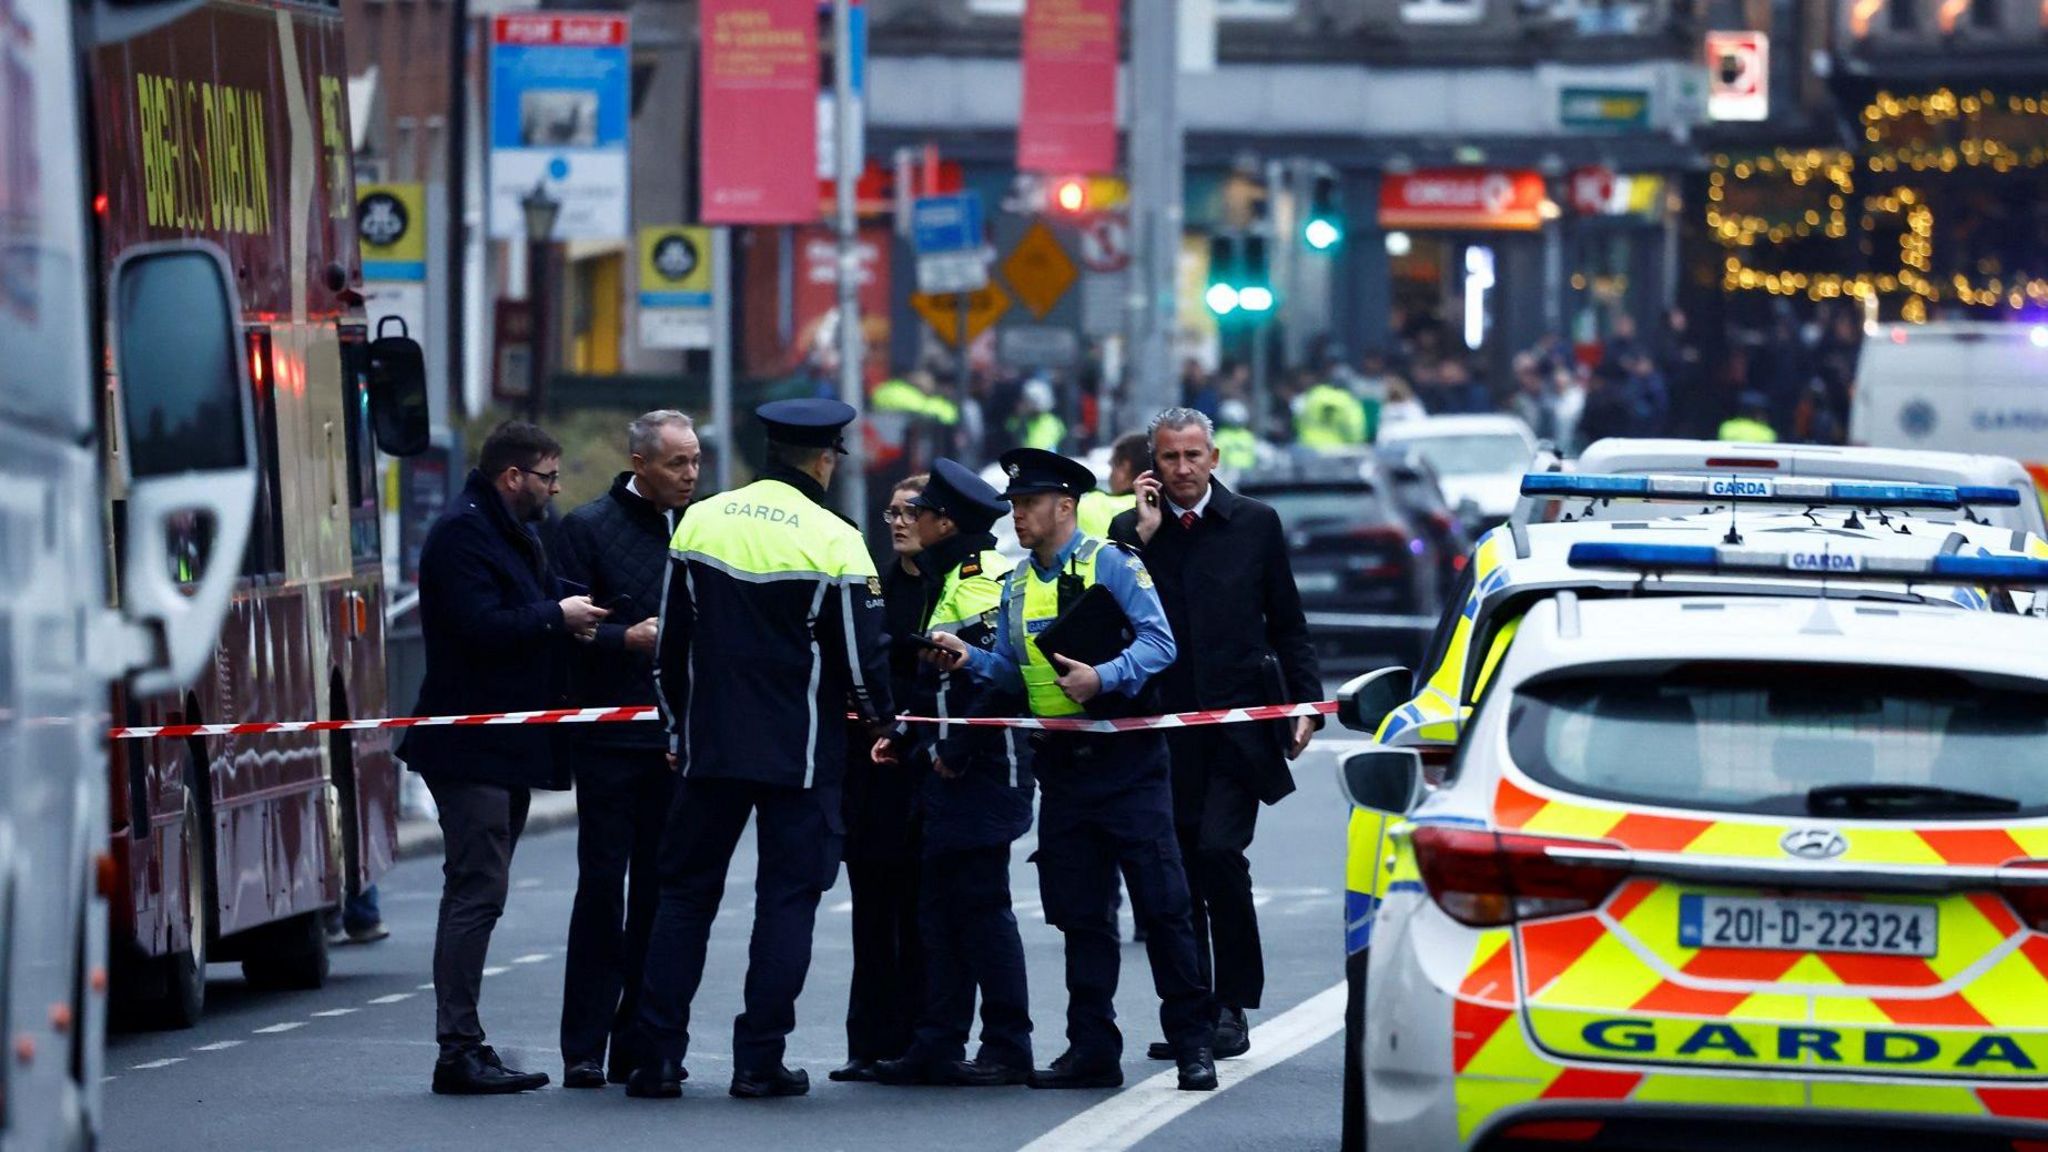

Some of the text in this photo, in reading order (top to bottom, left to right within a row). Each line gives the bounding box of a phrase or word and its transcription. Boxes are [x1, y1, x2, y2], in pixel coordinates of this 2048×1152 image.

[203, 82, 270, 235] DUBLIN
[1971, 408, 2048, 432] GARD
[1713, 481, 1767, 495] GARDA
[724, 502, 800, 528] GARDA
[1793, 553, 1856, 569] GARDA
[865, 598, 886, 609] GAR
[1028, 620, 1051, 632] GAR
[1713, 907, 1923, 950] 201-D-22324
[1581, 1019, 2038, 1070] GARDA
